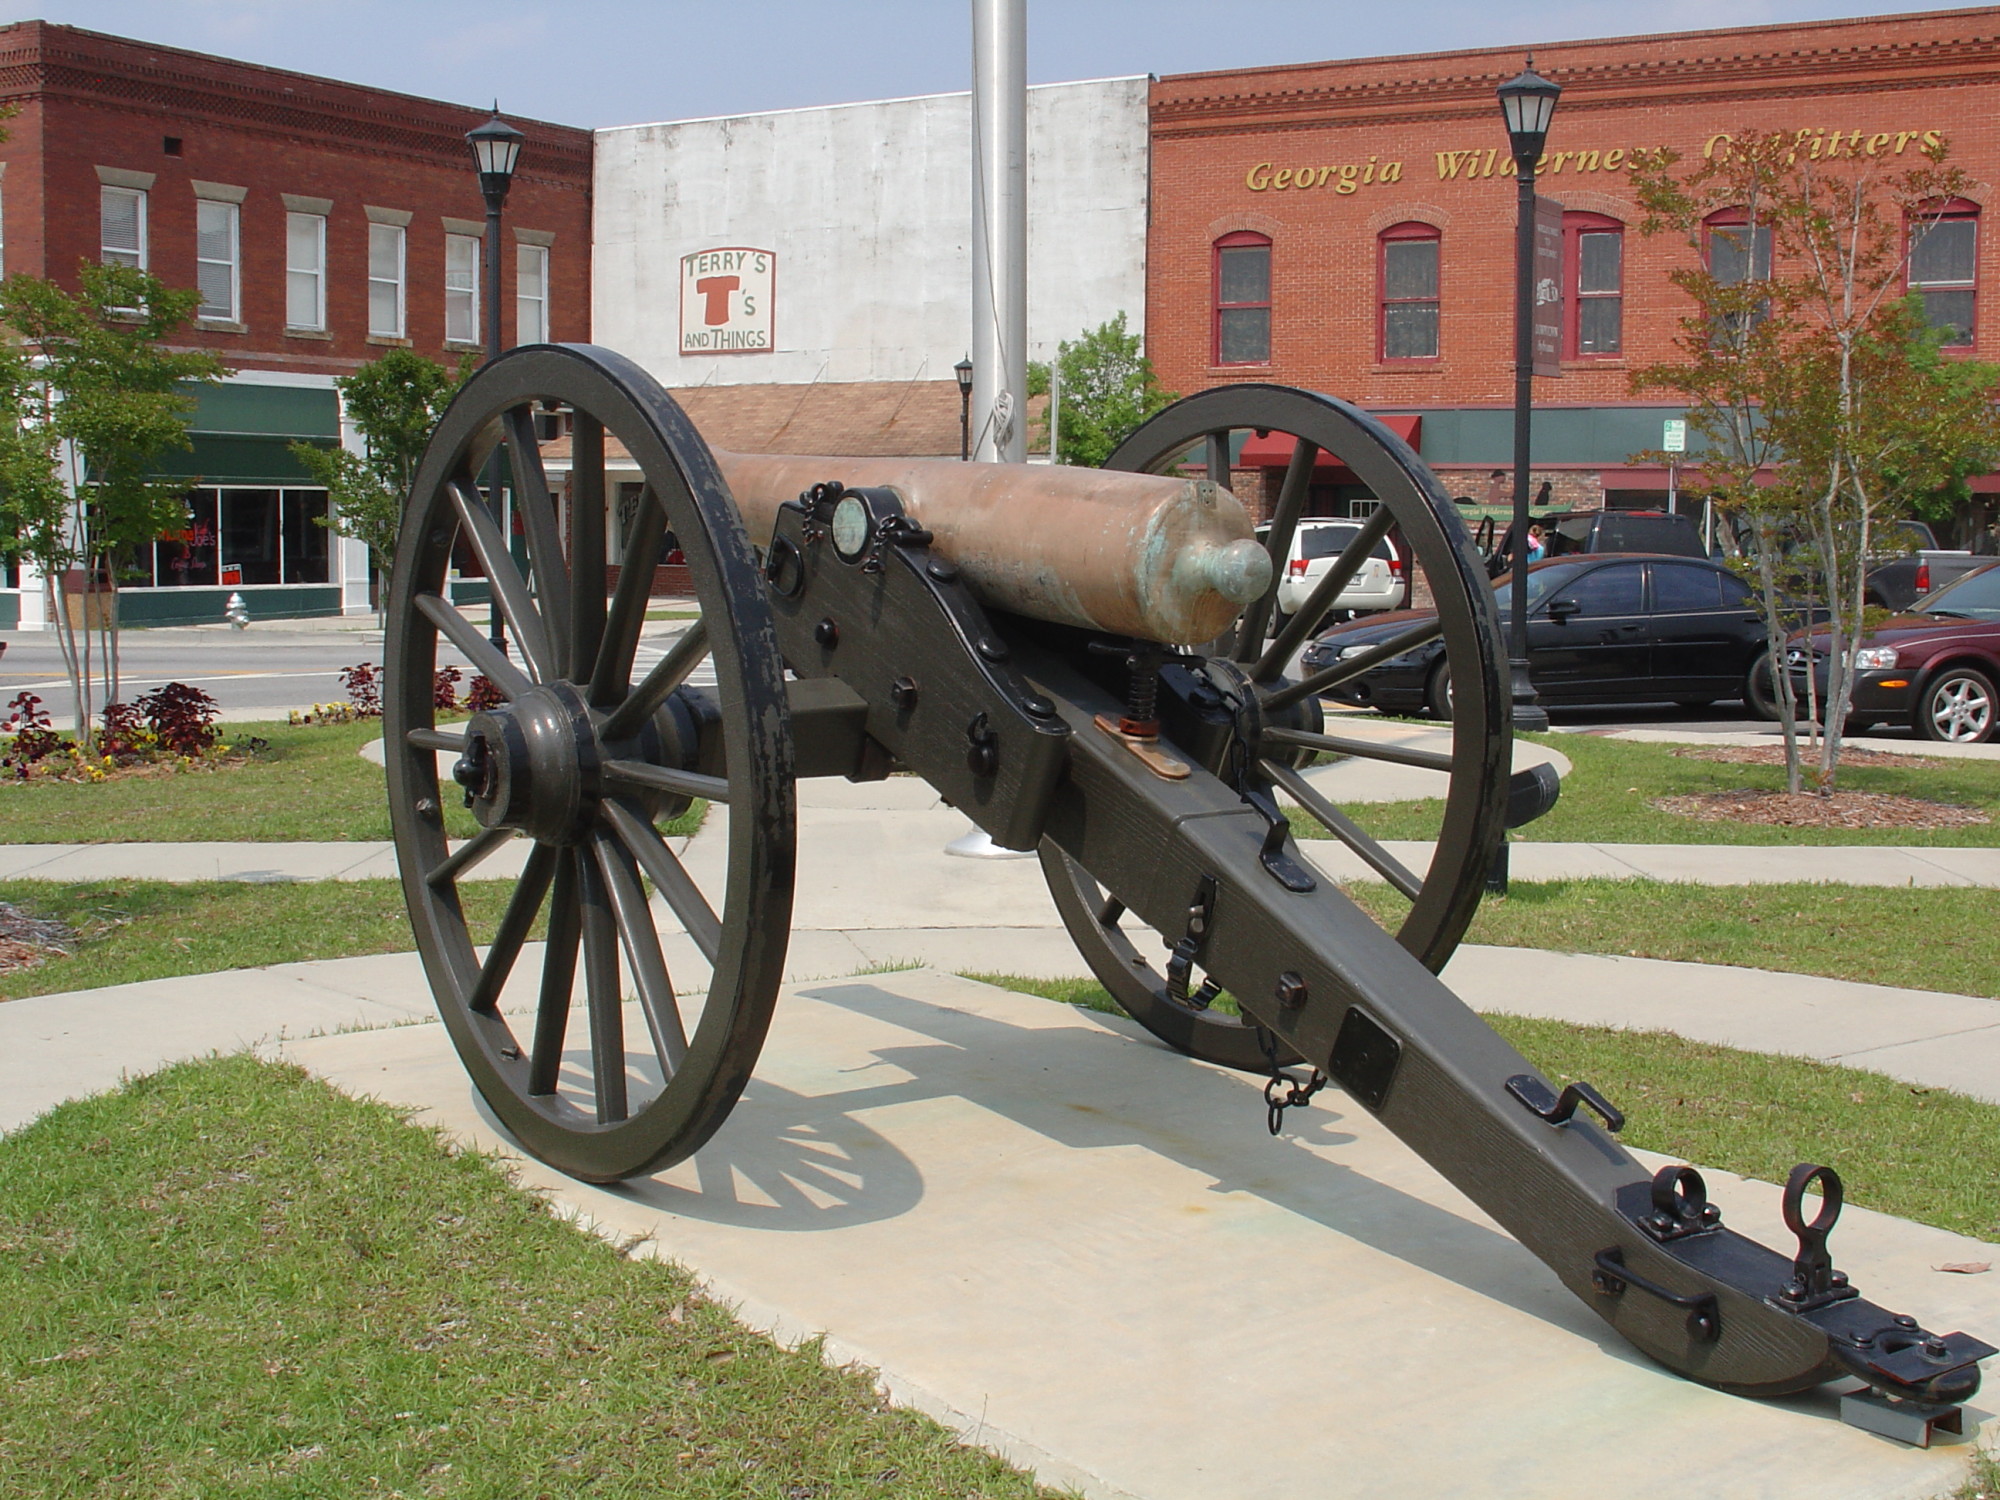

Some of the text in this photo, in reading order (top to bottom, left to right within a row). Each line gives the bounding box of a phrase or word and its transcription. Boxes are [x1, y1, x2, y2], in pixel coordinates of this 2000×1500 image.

[1246, 155, 1402, 194] Georgia
[1703, 127, 1944, 166] Ofitters
[685, 251, 766, 277] TERRY'S
[684, 328, 766, 349] AND THINGS
